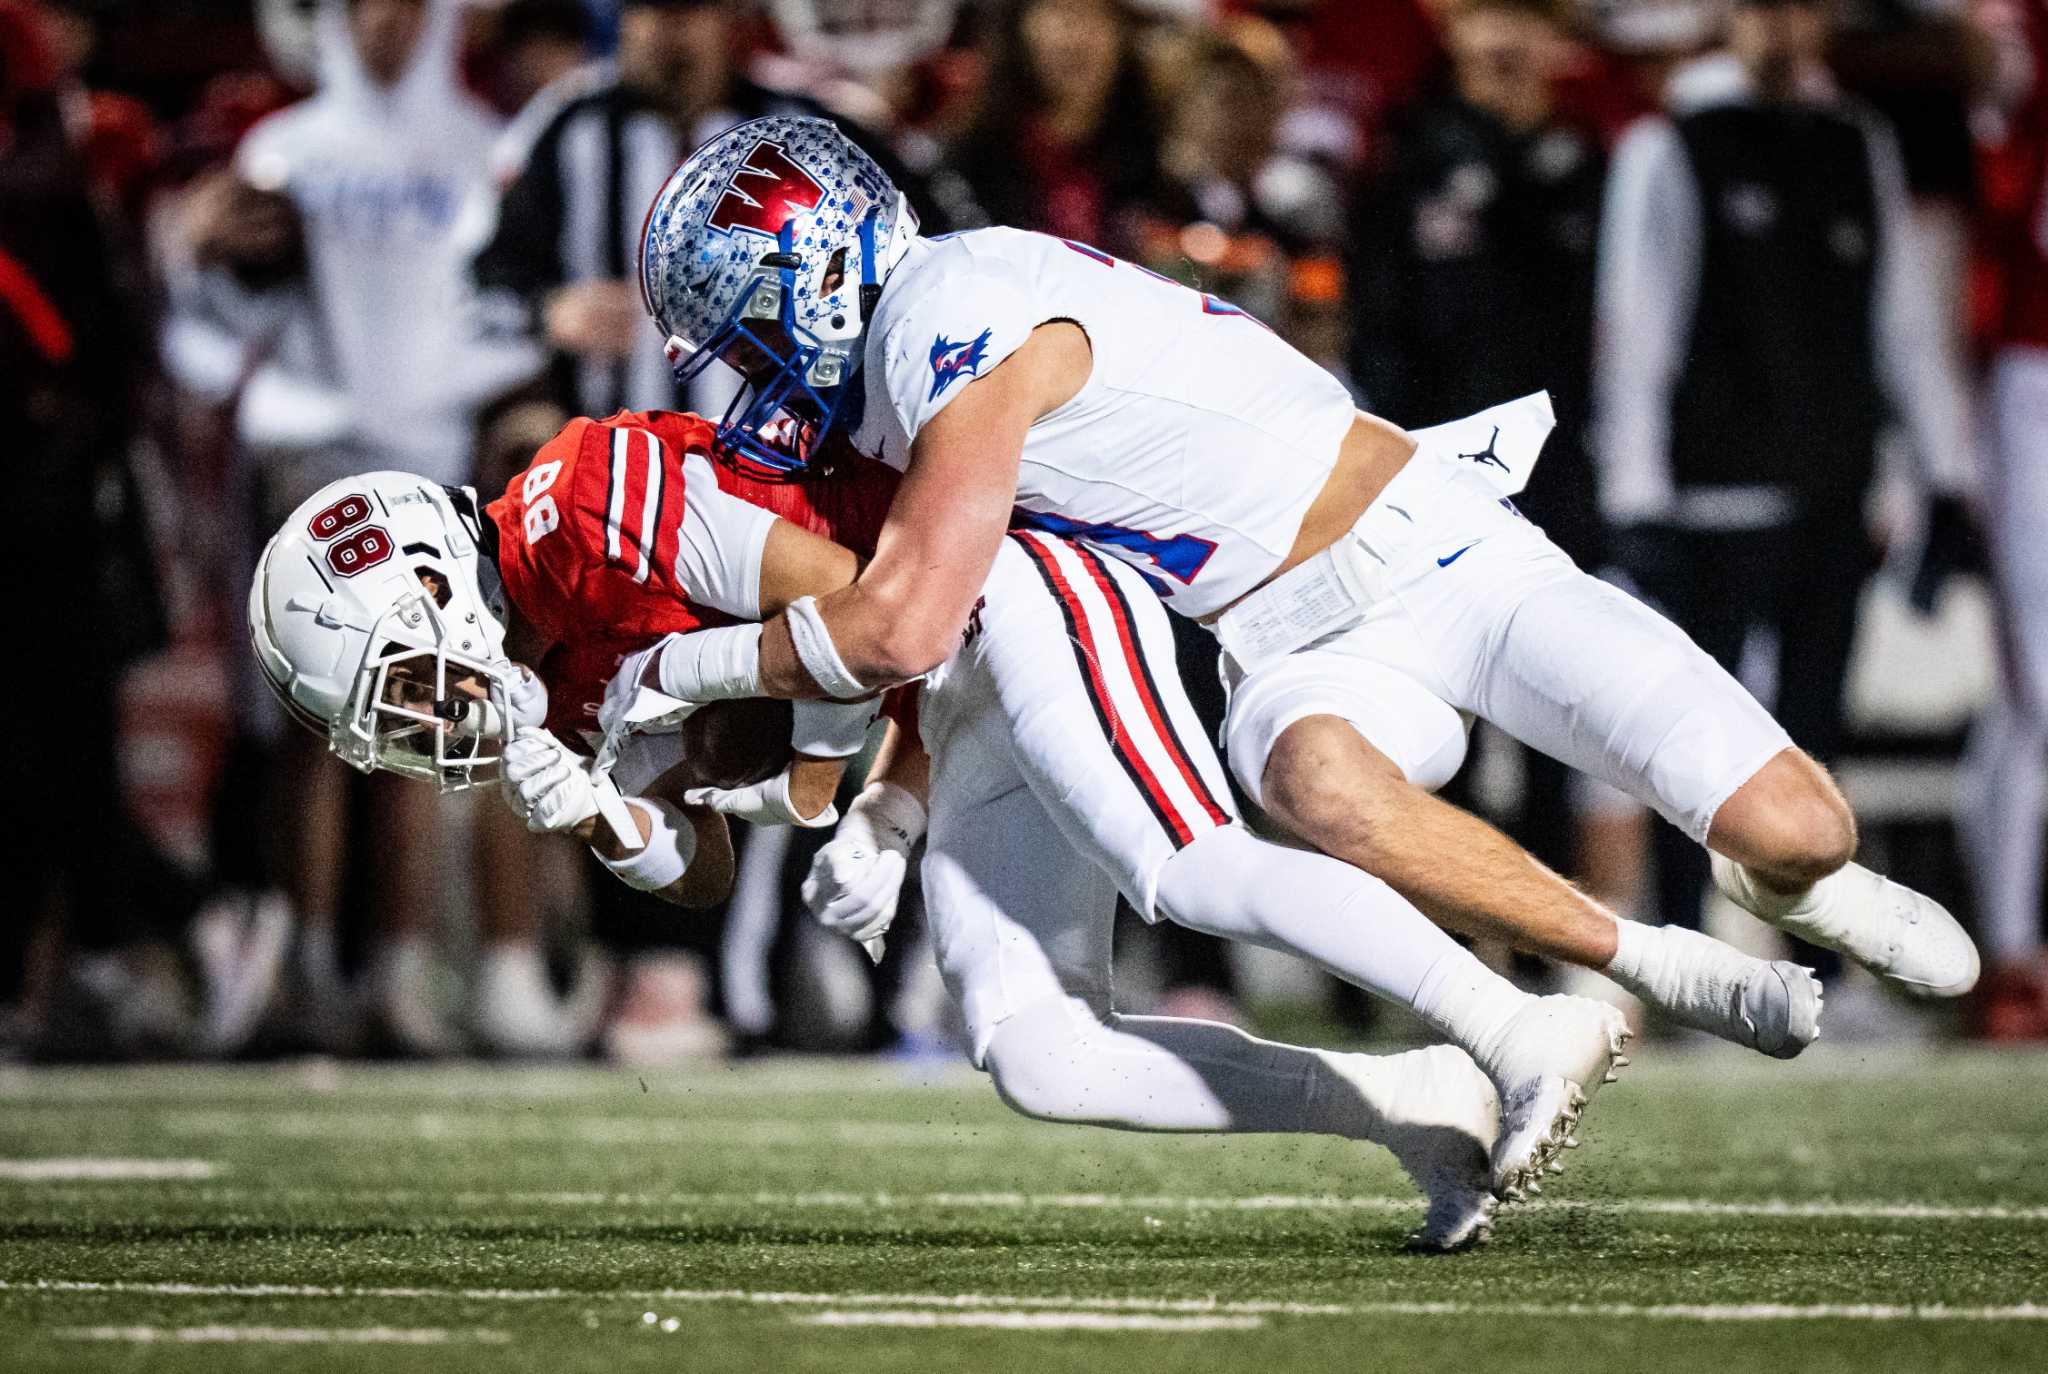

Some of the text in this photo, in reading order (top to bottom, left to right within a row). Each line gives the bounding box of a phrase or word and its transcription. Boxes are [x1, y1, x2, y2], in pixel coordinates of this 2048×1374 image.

[704, 137, 829, 242] W
[307, 493, 395, 578] 88
[523, 459, 563, 545] 88
